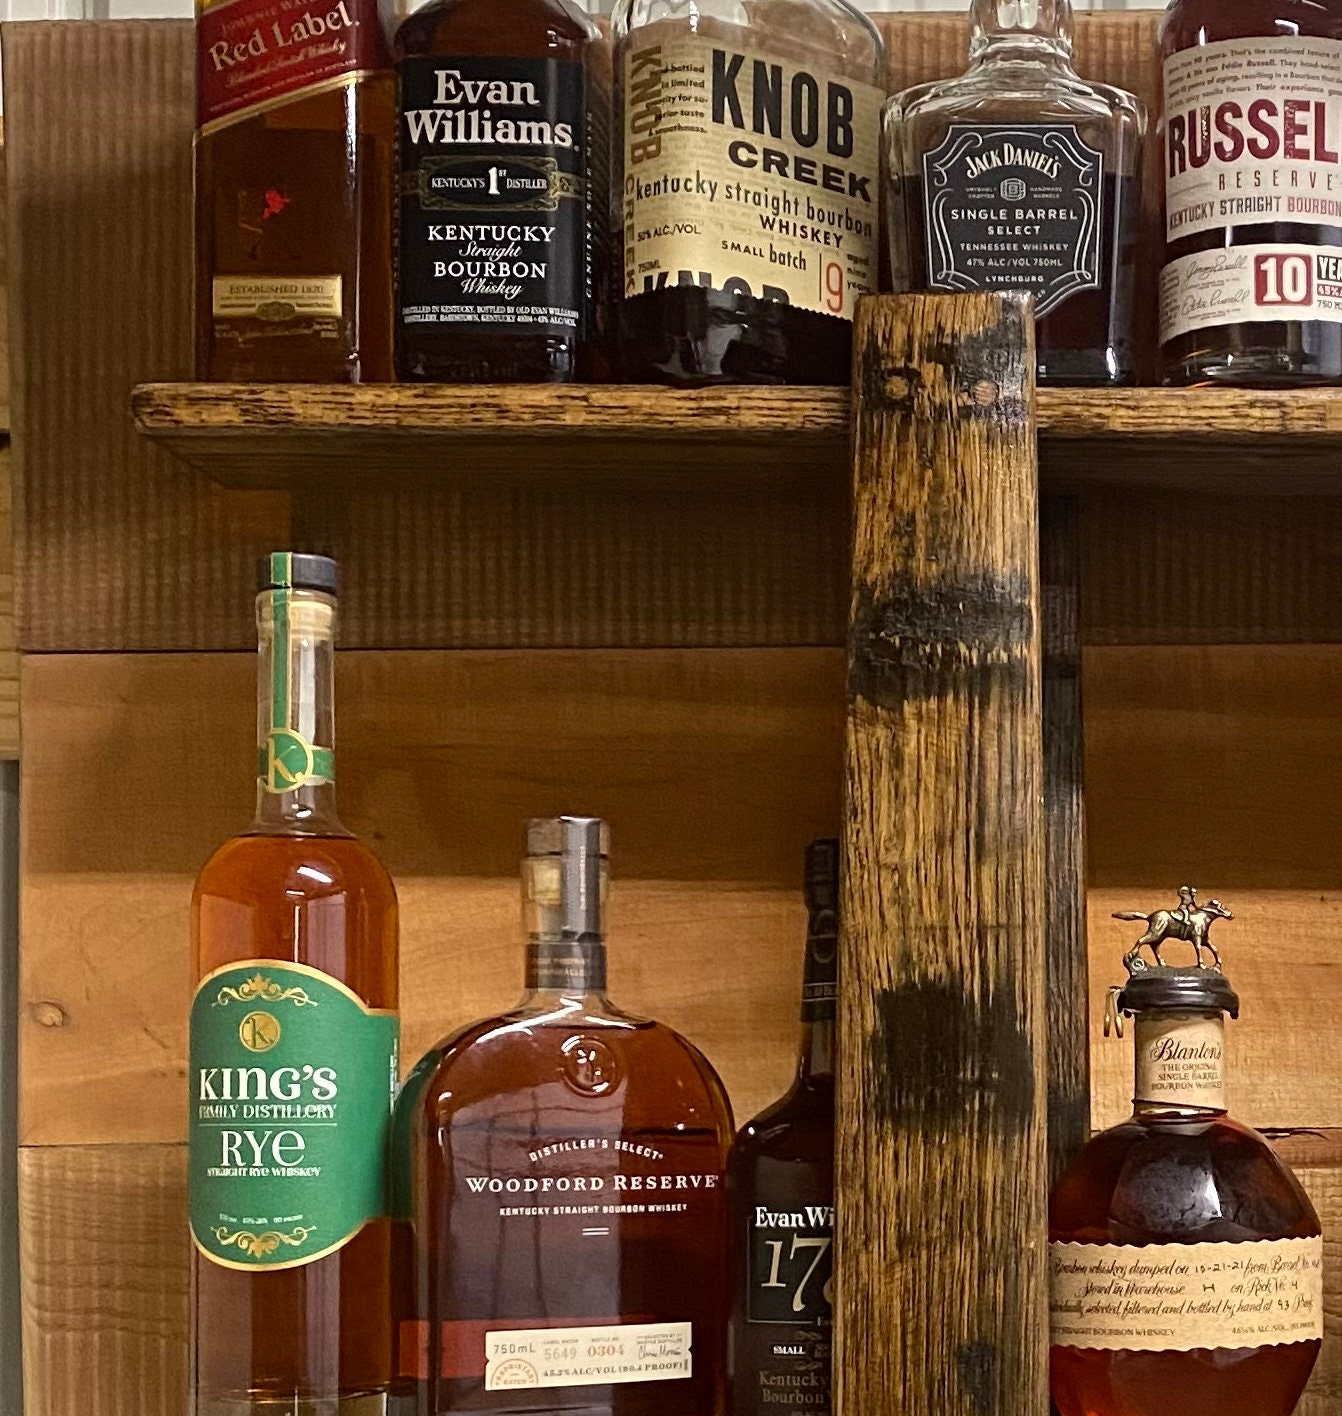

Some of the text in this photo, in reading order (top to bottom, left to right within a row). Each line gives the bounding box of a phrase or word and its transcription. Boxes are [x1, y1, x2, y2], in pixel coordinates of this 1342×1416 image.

[209, 38, 266, 72] Red
[433, 69, 540, 106] Evan
[631, 46, 662, 166] KNOB
[712, 49, 854, 159] KNOB
[404, 108, 574, 148] Williams
[728, 140, 872, 203] CREEK
[965, 143, 1062, 179] JACK DANIEL'S
[431, 177, 486, 189] KENTUCKY'S
[506, 177, 548, 189] DISTILLER
[1219, 169, 1334, 191] RESERVE
[636, 170, 872, 238] kentucky straight bourbon
[951, 209, 1078, 220] SINGLE BARREL
[1170, 201, 1215, 230] KENTUCKY
[1220, 196, 1282, 216] STRAIGHT
[1288, 196, 1342, 217] BOURBON
[428, 225, 556, 243] KENTUCKY
[760, 214, 844, 249] WHISKEY
[988, 226, 1041, 235] SELECT
[458, 241, 523, 259] Straight
[722, 240, 807, 271] SMALL batch
[960, 243, 1018, 251] TENNESSEE
[434, 262, 546, 278] BOURBON
[1260, 257, 1308, 303] 10
[229, 284, 299, 294] ESTABLISHED
[460, 278, 524, 300] Whiskey
[827, 262, 844, 312] 9
[1151, 1036, 1222, 1063] Blanton's
[1158, 1072, 1190, 1081] SINGLE
[528, 1139, 658, 1162] DISTILLER'S SELECT
[465, 1174, 716, 1193] WOODFORD RESERVE
[499, 1204, 687, 1216] KENTUCKY STRAIGHT BOURBON WHISKEY
[755, 1207, 806, 1228] Evan
[761, 1232, 833, 1312] 17
[773, 1346, 806, 1354] SMALL
